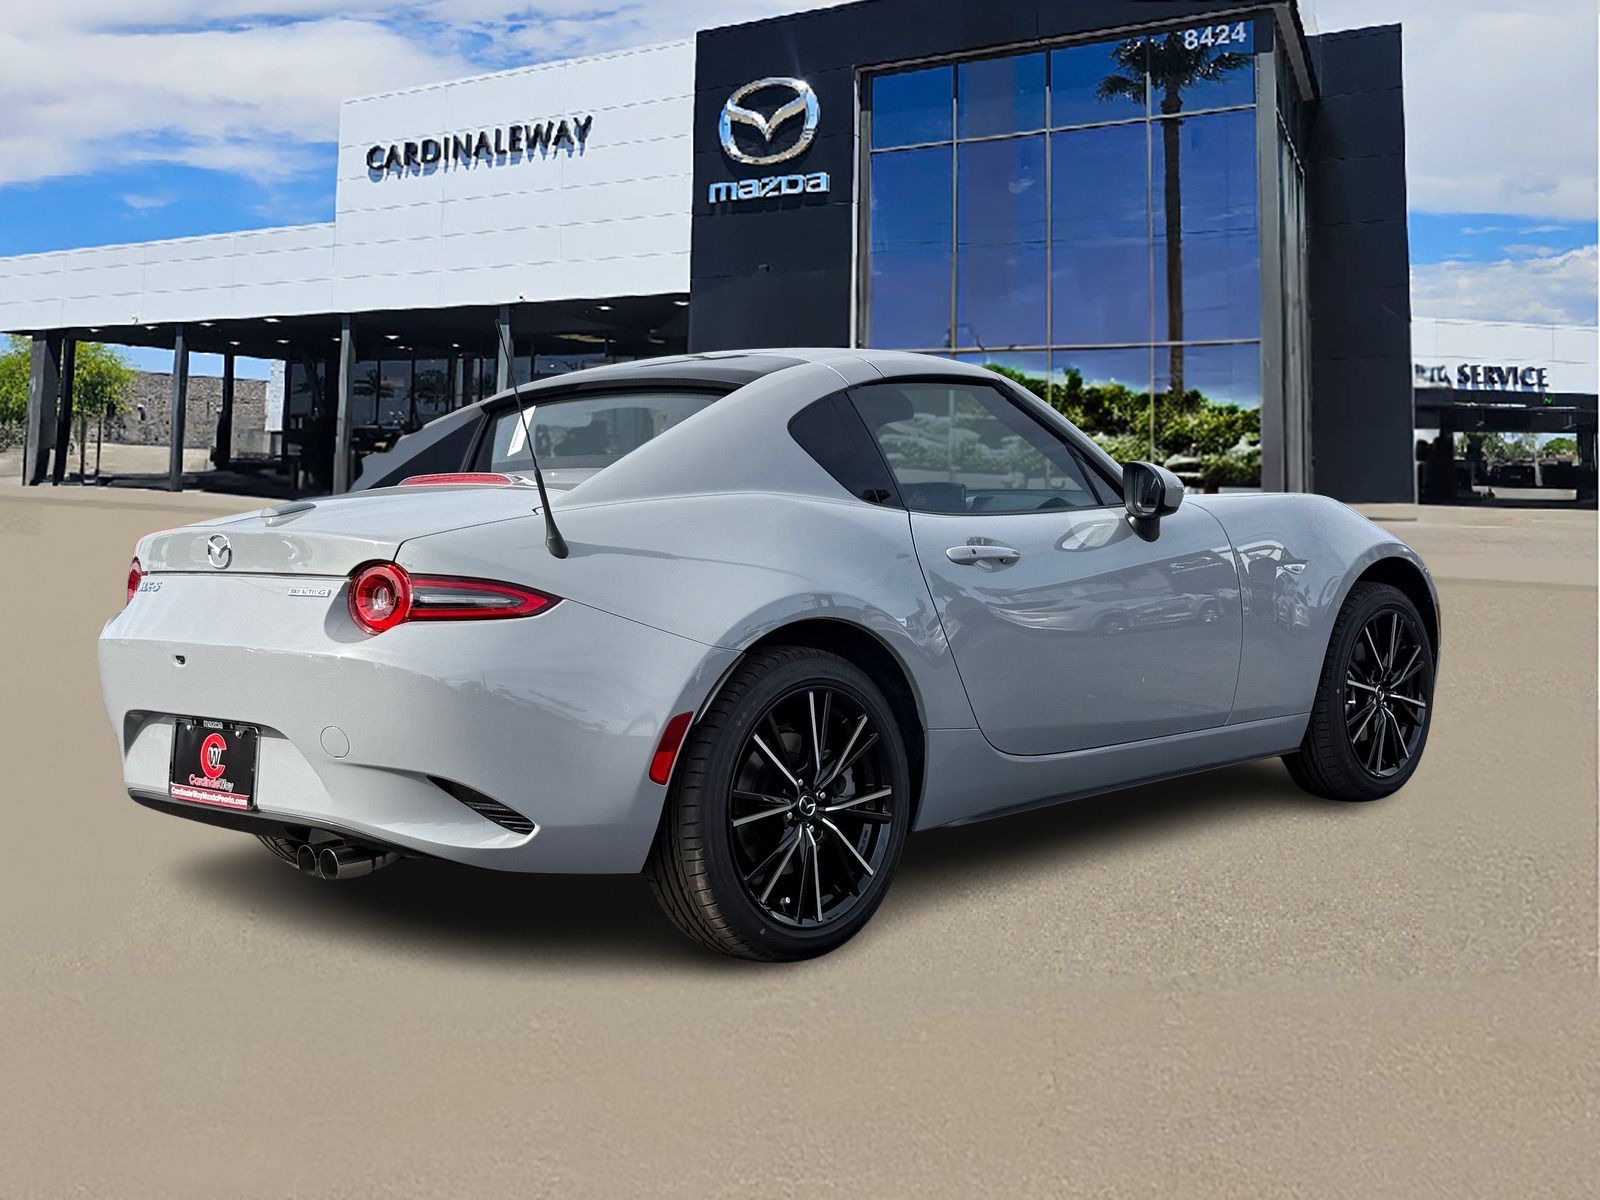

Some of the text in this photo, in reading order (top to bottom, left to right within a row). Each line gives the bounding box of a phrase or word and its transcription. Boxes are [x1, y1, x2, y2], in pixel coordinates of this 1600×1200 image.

[1184, 22, 1246, 49] 8424
[366, 115, 593, 170] CARDINALEWAY
[1457, 363, 1549, 387] SERVICE
